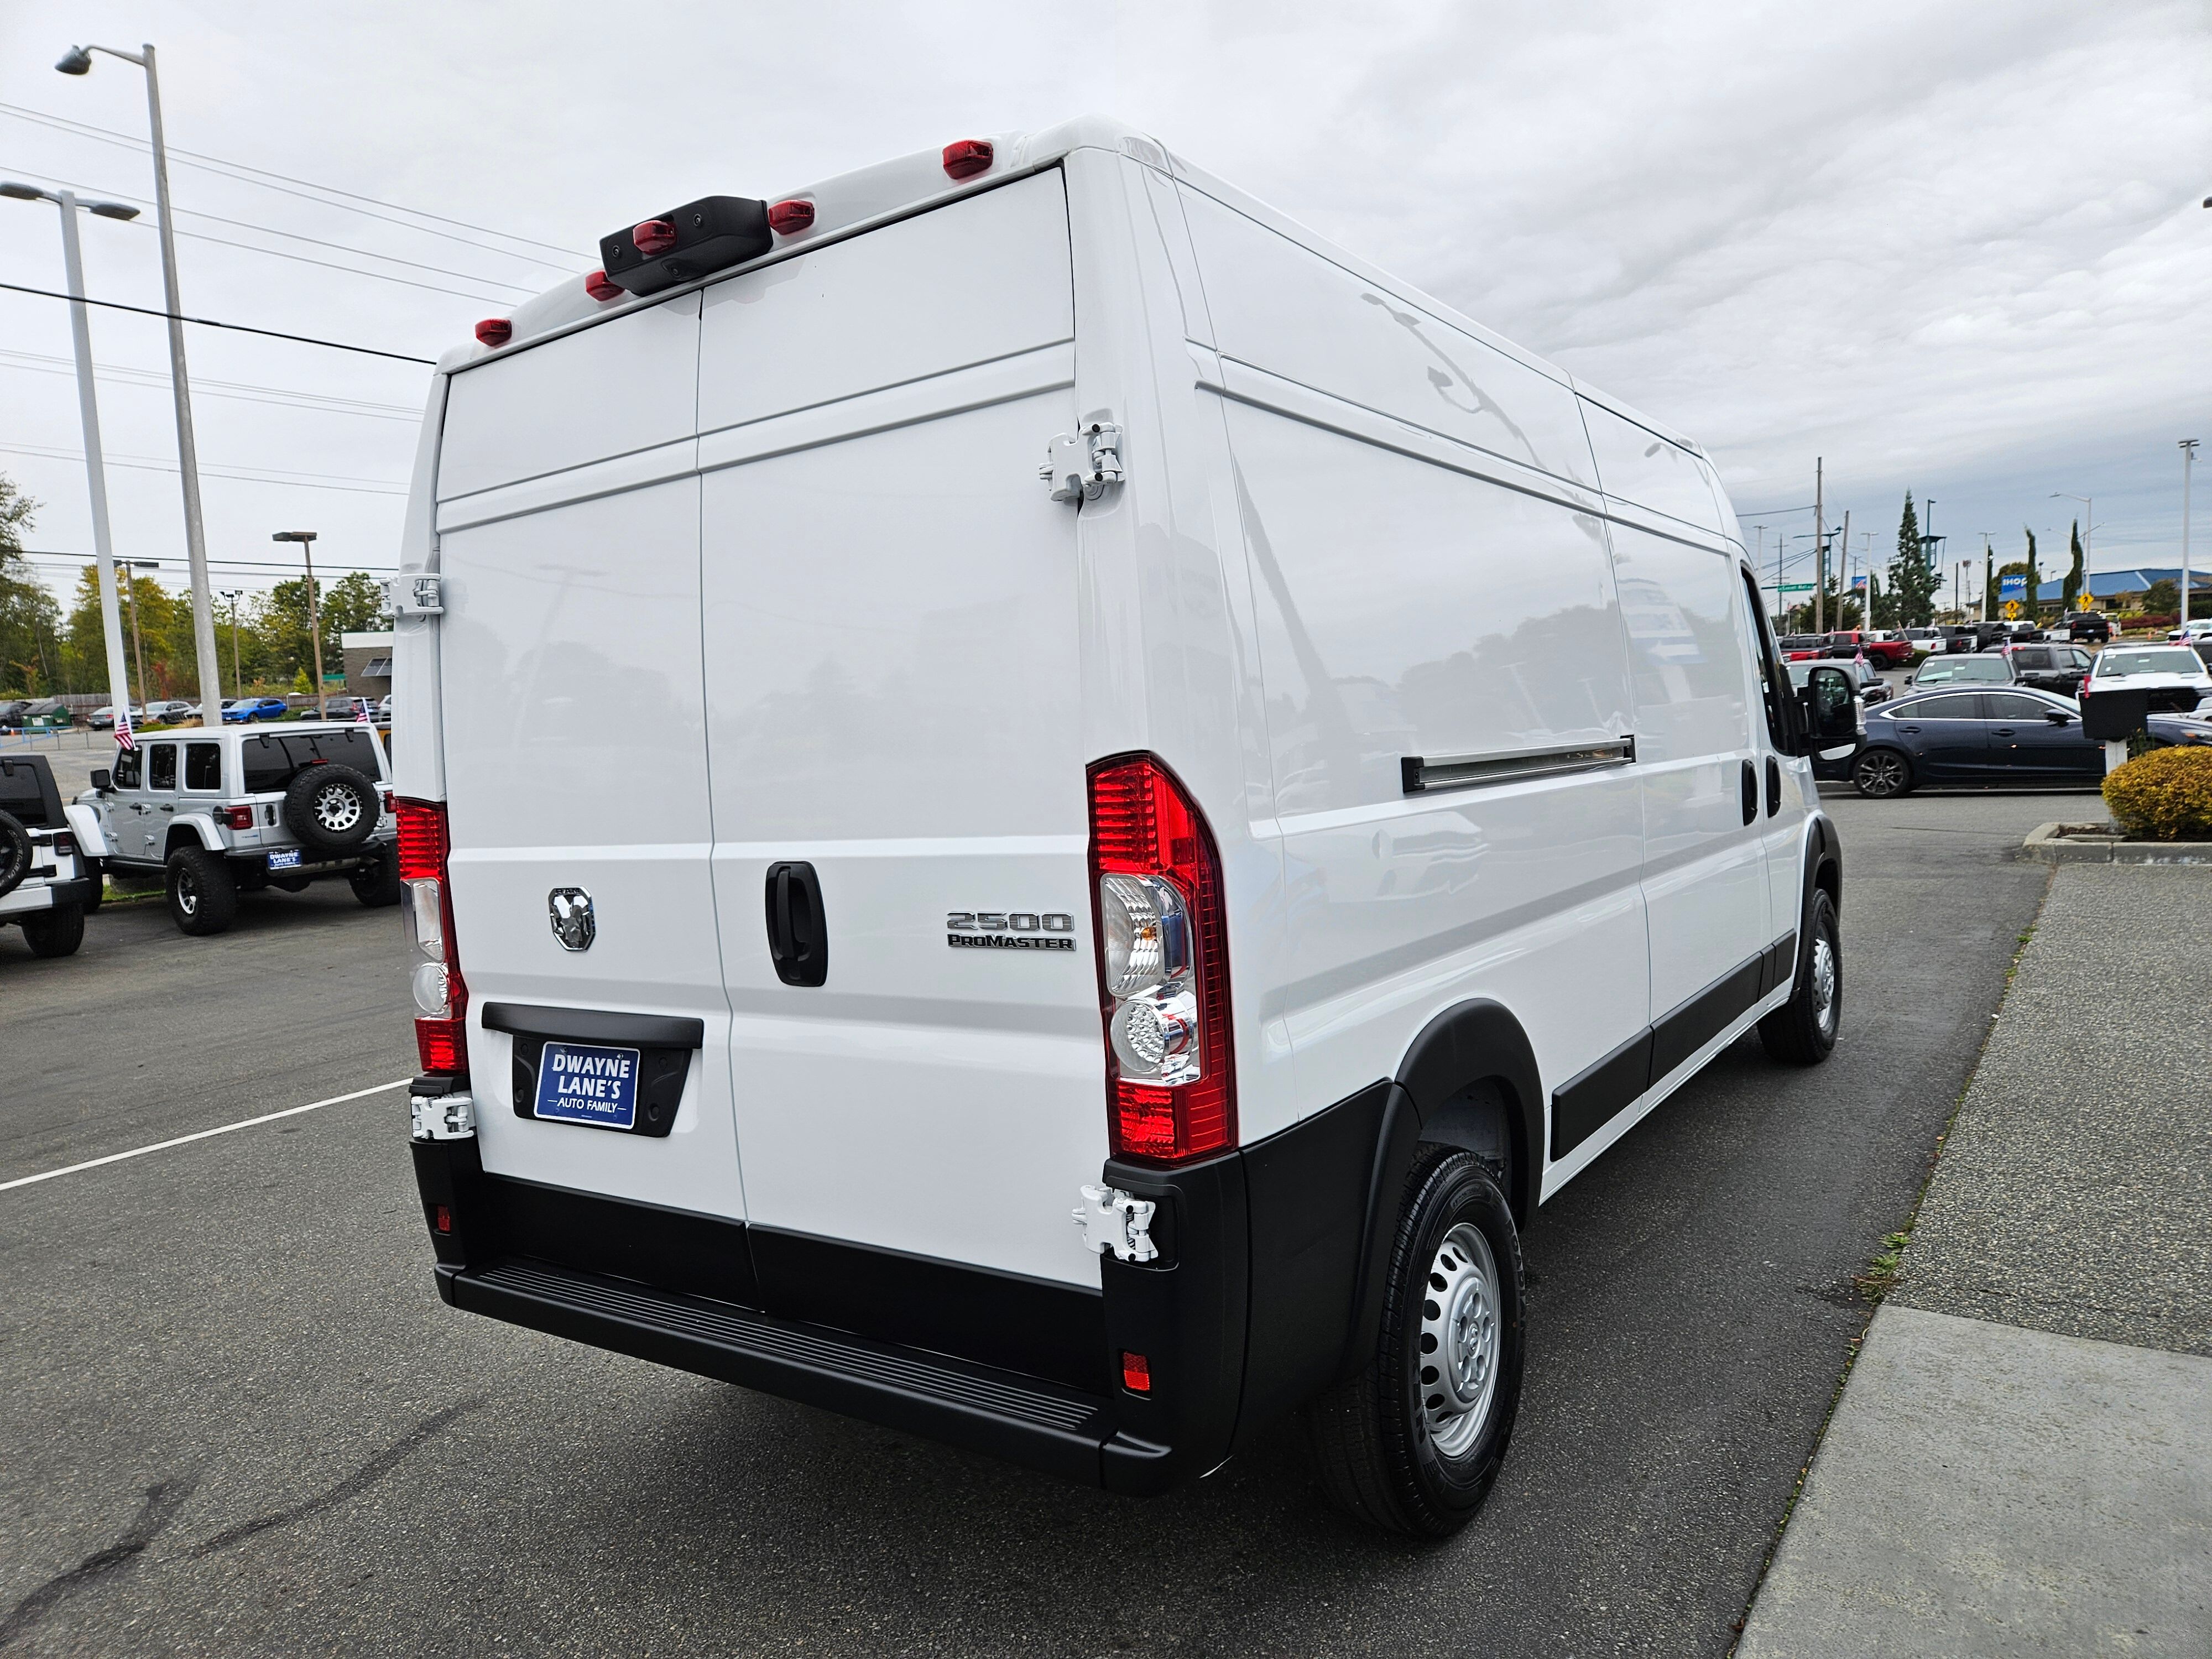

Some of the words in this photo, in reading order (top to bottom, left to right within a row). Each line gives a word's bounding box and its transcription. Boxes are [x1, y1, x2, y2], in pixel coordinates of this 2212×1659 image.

[947, 911, 1074, 932] 2500
[553, 1054, 630, 1078] DWAYNE
[557, 1075, 621, 1099] LANE'S
[557, 1097, 584, 1109] AUTO
[587, 1100, 618, 1113] FAMILY
